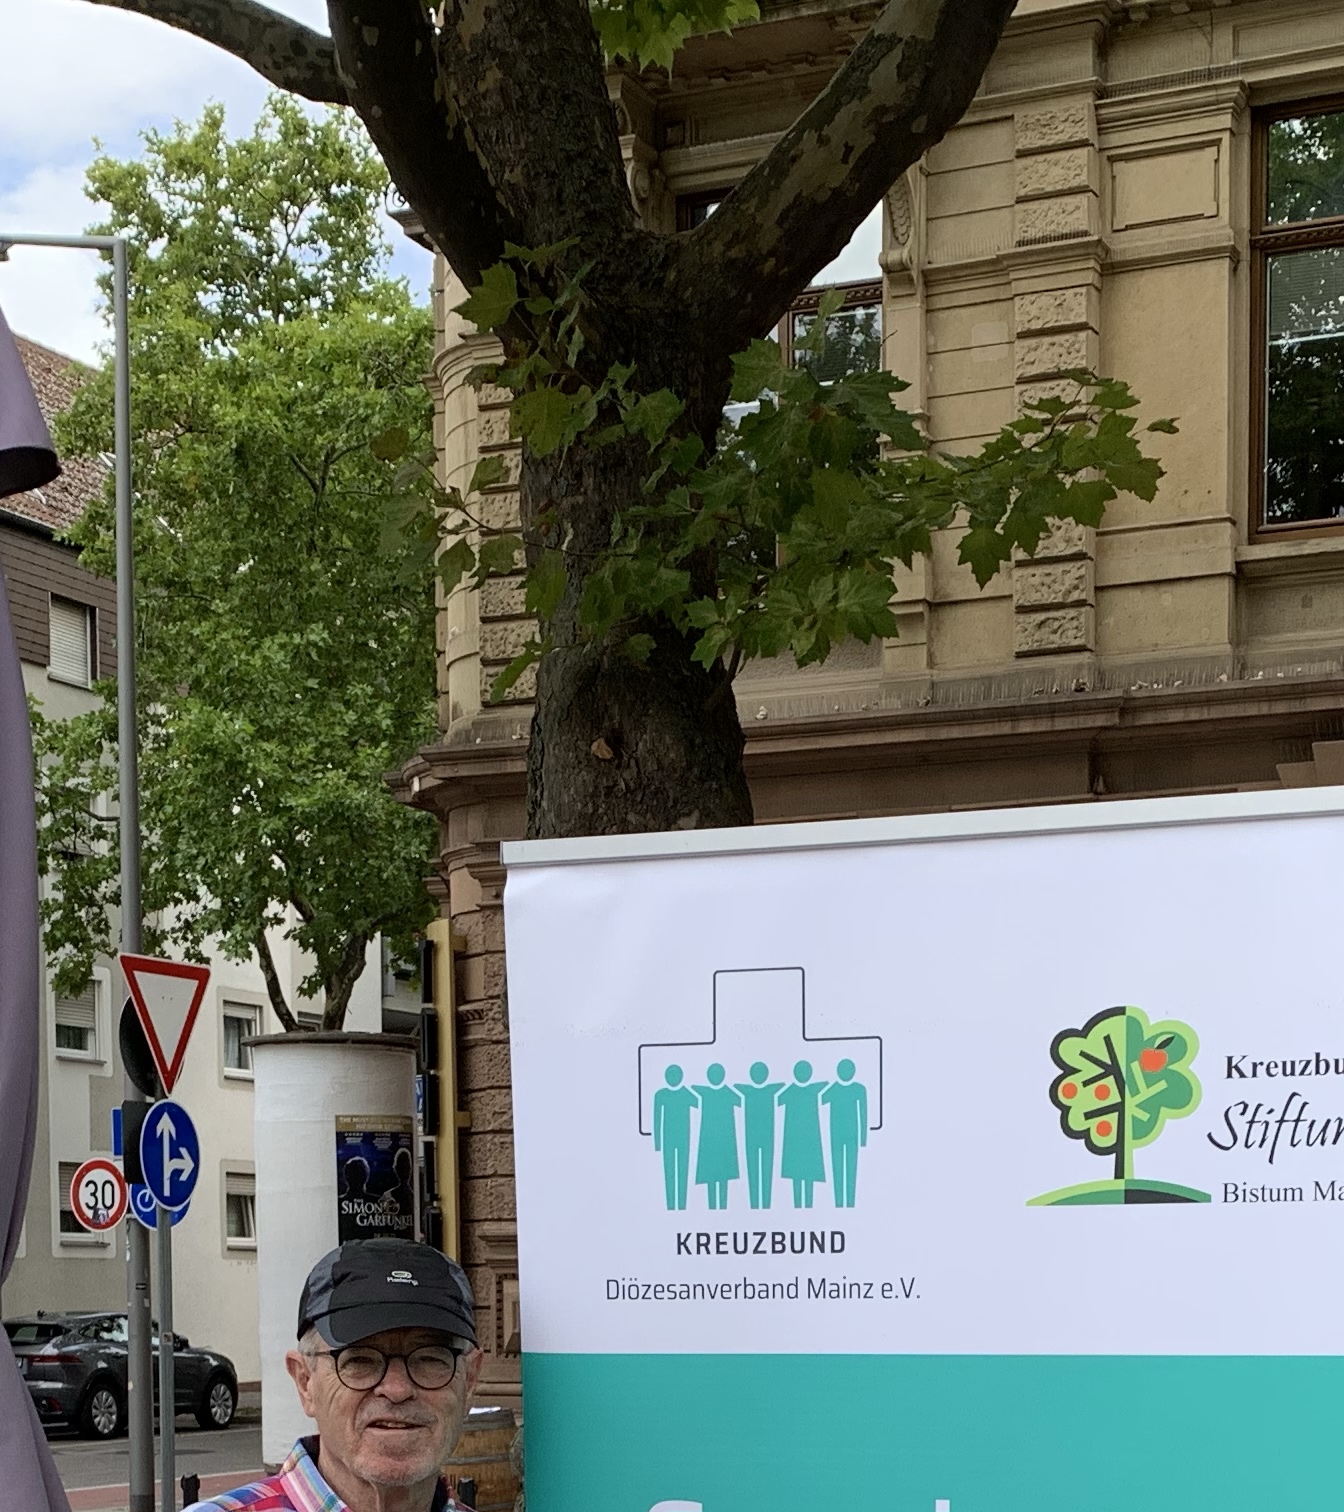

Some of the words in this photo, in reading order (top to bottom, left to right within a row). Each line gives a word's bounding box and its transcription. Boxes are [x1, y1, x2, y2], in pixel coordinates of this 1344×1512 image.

[85, 1179, 115, 1210] 30
[1221, 1181, 1303, 1204] Bistum
[342, 1200, 383, 1214] SIMON
[676, 1229, 846, 1257] KREUZBUND
[605, 1274, 799, 1303] Diözesanverband
[807, 1276, 874, 1302] Mainz
[880, 1278, 921, 1301] e.V.
